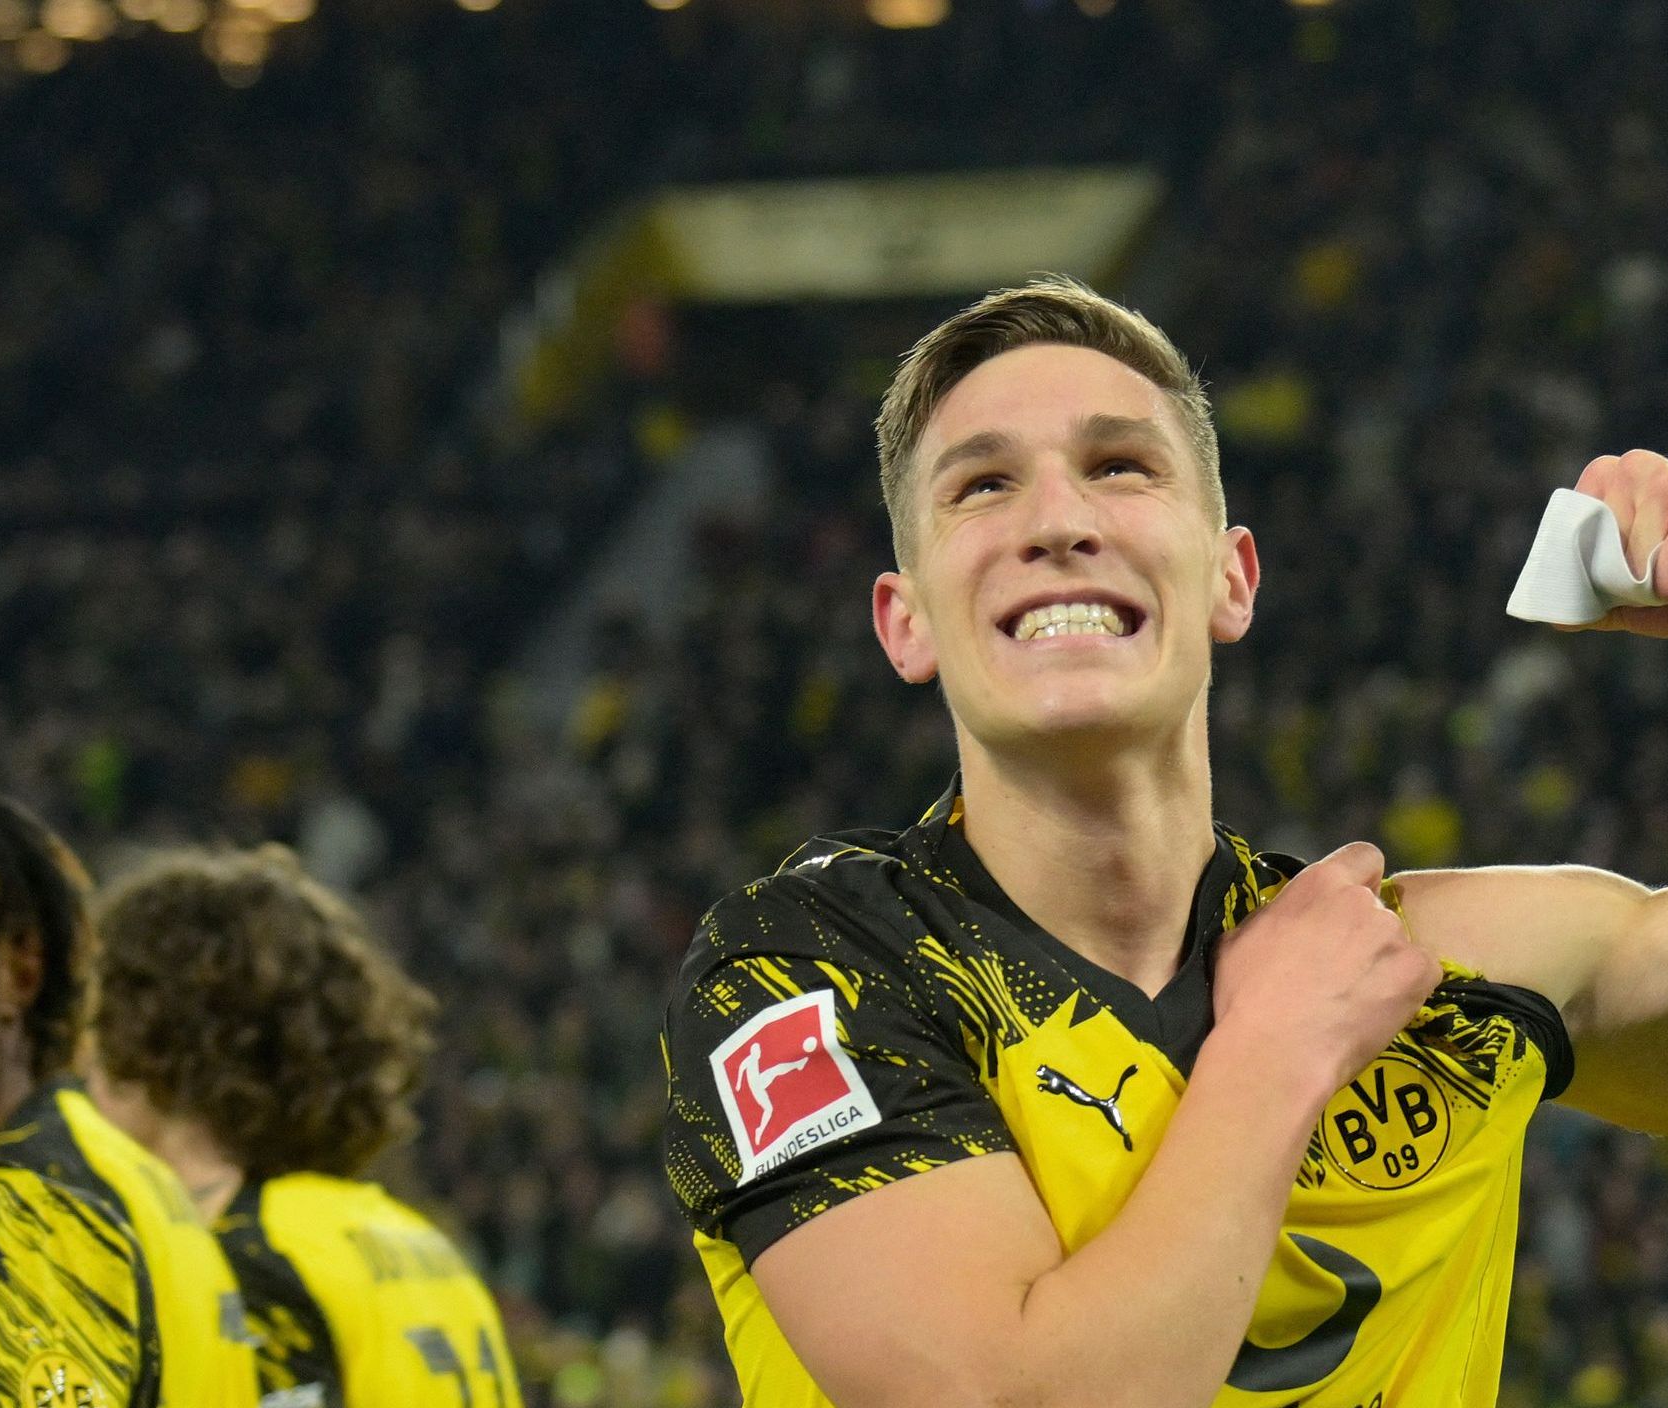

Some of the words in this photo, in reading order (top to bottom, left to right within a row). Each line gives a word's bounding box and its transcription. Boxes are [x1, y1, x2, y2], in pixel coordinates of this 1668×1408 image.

[755, 1105, 863, 1177] BUNDESLIGA
[1333, 1066, 1438, 1165] BVB
[1383, 1144, 1420, 1179] 09
